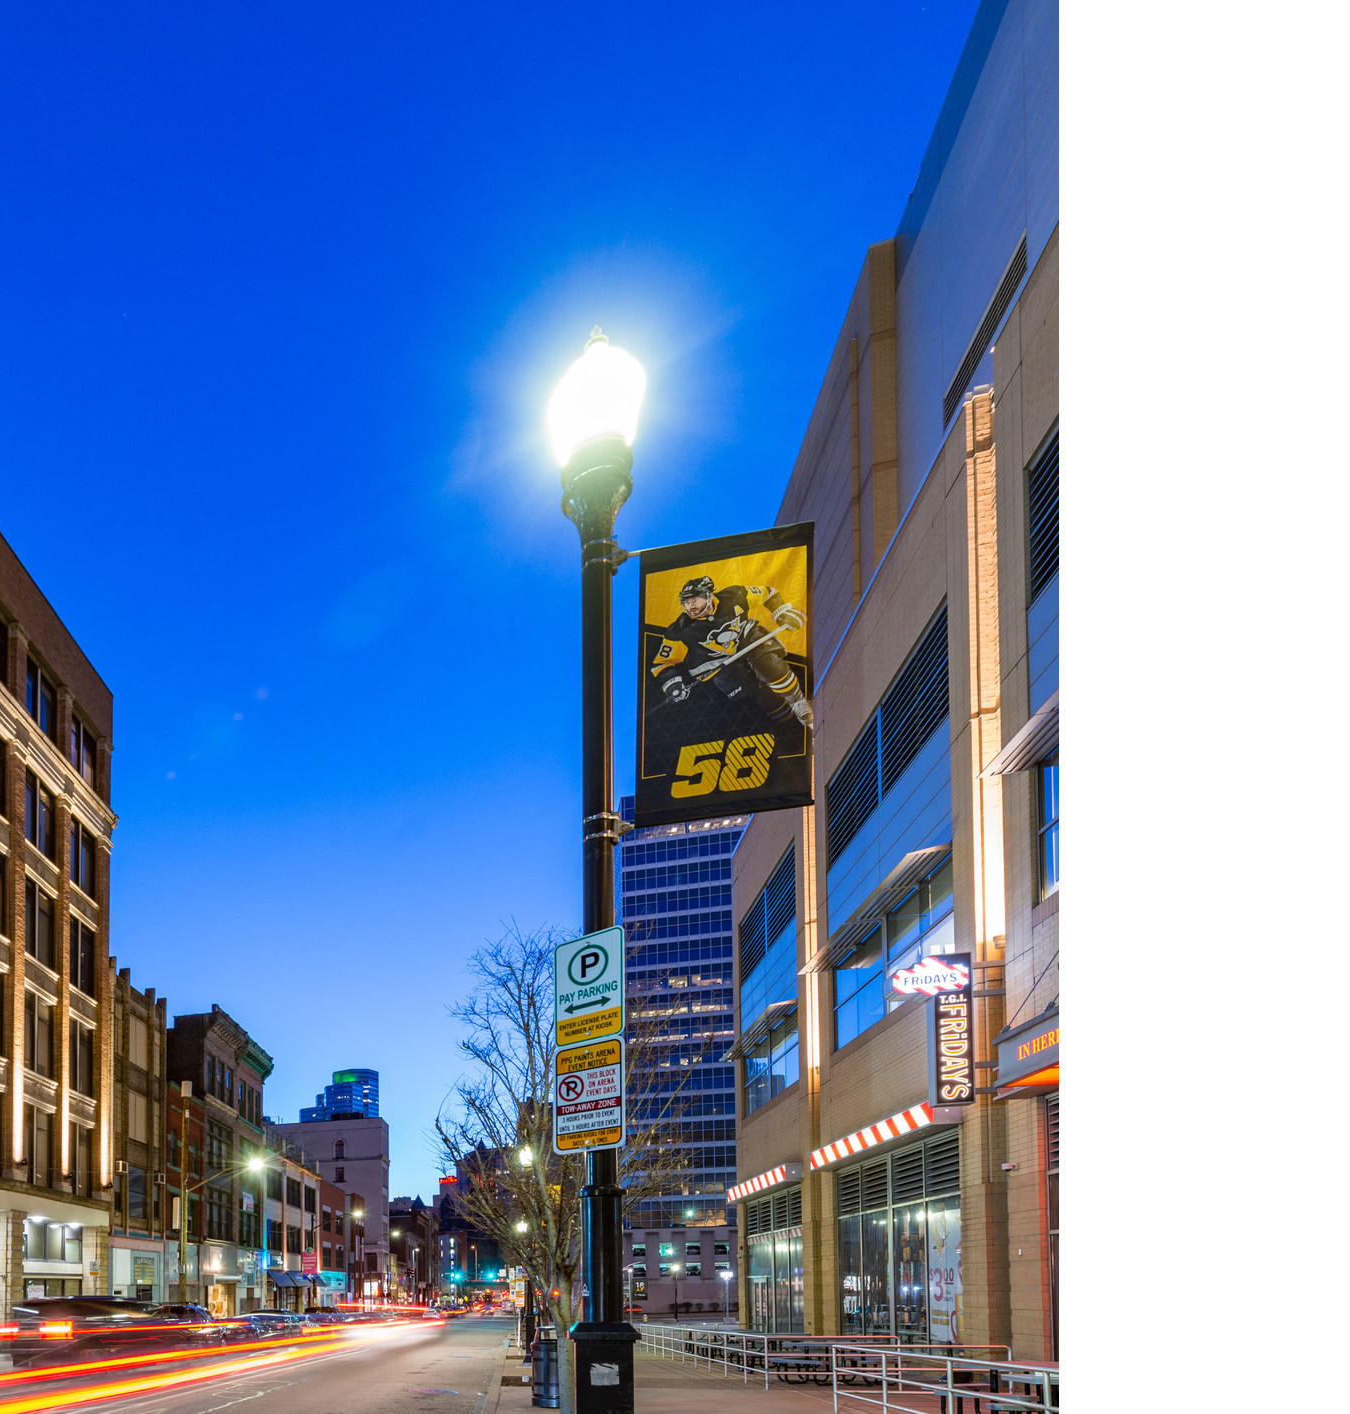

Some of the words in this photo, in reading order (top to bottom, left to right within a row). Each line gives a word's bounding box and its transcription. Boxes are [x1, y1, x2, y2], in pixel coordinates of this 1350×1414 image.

[671, 733, 775, 799] 58
[559, 992, 575, 1005] PAY
[578, 980, 618, 1000] PARKING
[939, 994, 967, 1004] T.G.I.
[559, 1022, 576, 1031] ENTER
[578, 1015, 600, 1026] LICENSE
[601, 1011, 618, 1021] PLATE
[564, 1027, 587, 1037] NUMBER
[596, 1021, 613, 1030] KIOSK
[561, 1057, 573, 1065] PPG
[574, 1051, 594, 1062] PAINTS
[595, 1047, 616, 1058] ARENA
[1018, 1042, 1030, 1060] IN
[568, 1062, 586, 1071] EVENT
[587, 1057, 608, 1067] NOTICE
[587, 1071, 599, 1080] THIS
[599, 1068, 616, 1077] BLOCK
[597, 1077, 615, 1086] ARENA
[586, 1088, 602, 1097] EVENT
[603, 1085, 617, 1094] DAYS
[561, 1102, 596, 1114] TOW-AWAY
[598, 1098, 617, 1108] ZONE
[602, 1109, 615, 1117] EVENT
[576, 1122, 590, 1130] HOURS
[591, 1120, 604, 1128] AFTER
[605, 1118, 619, 1126] EVENT
